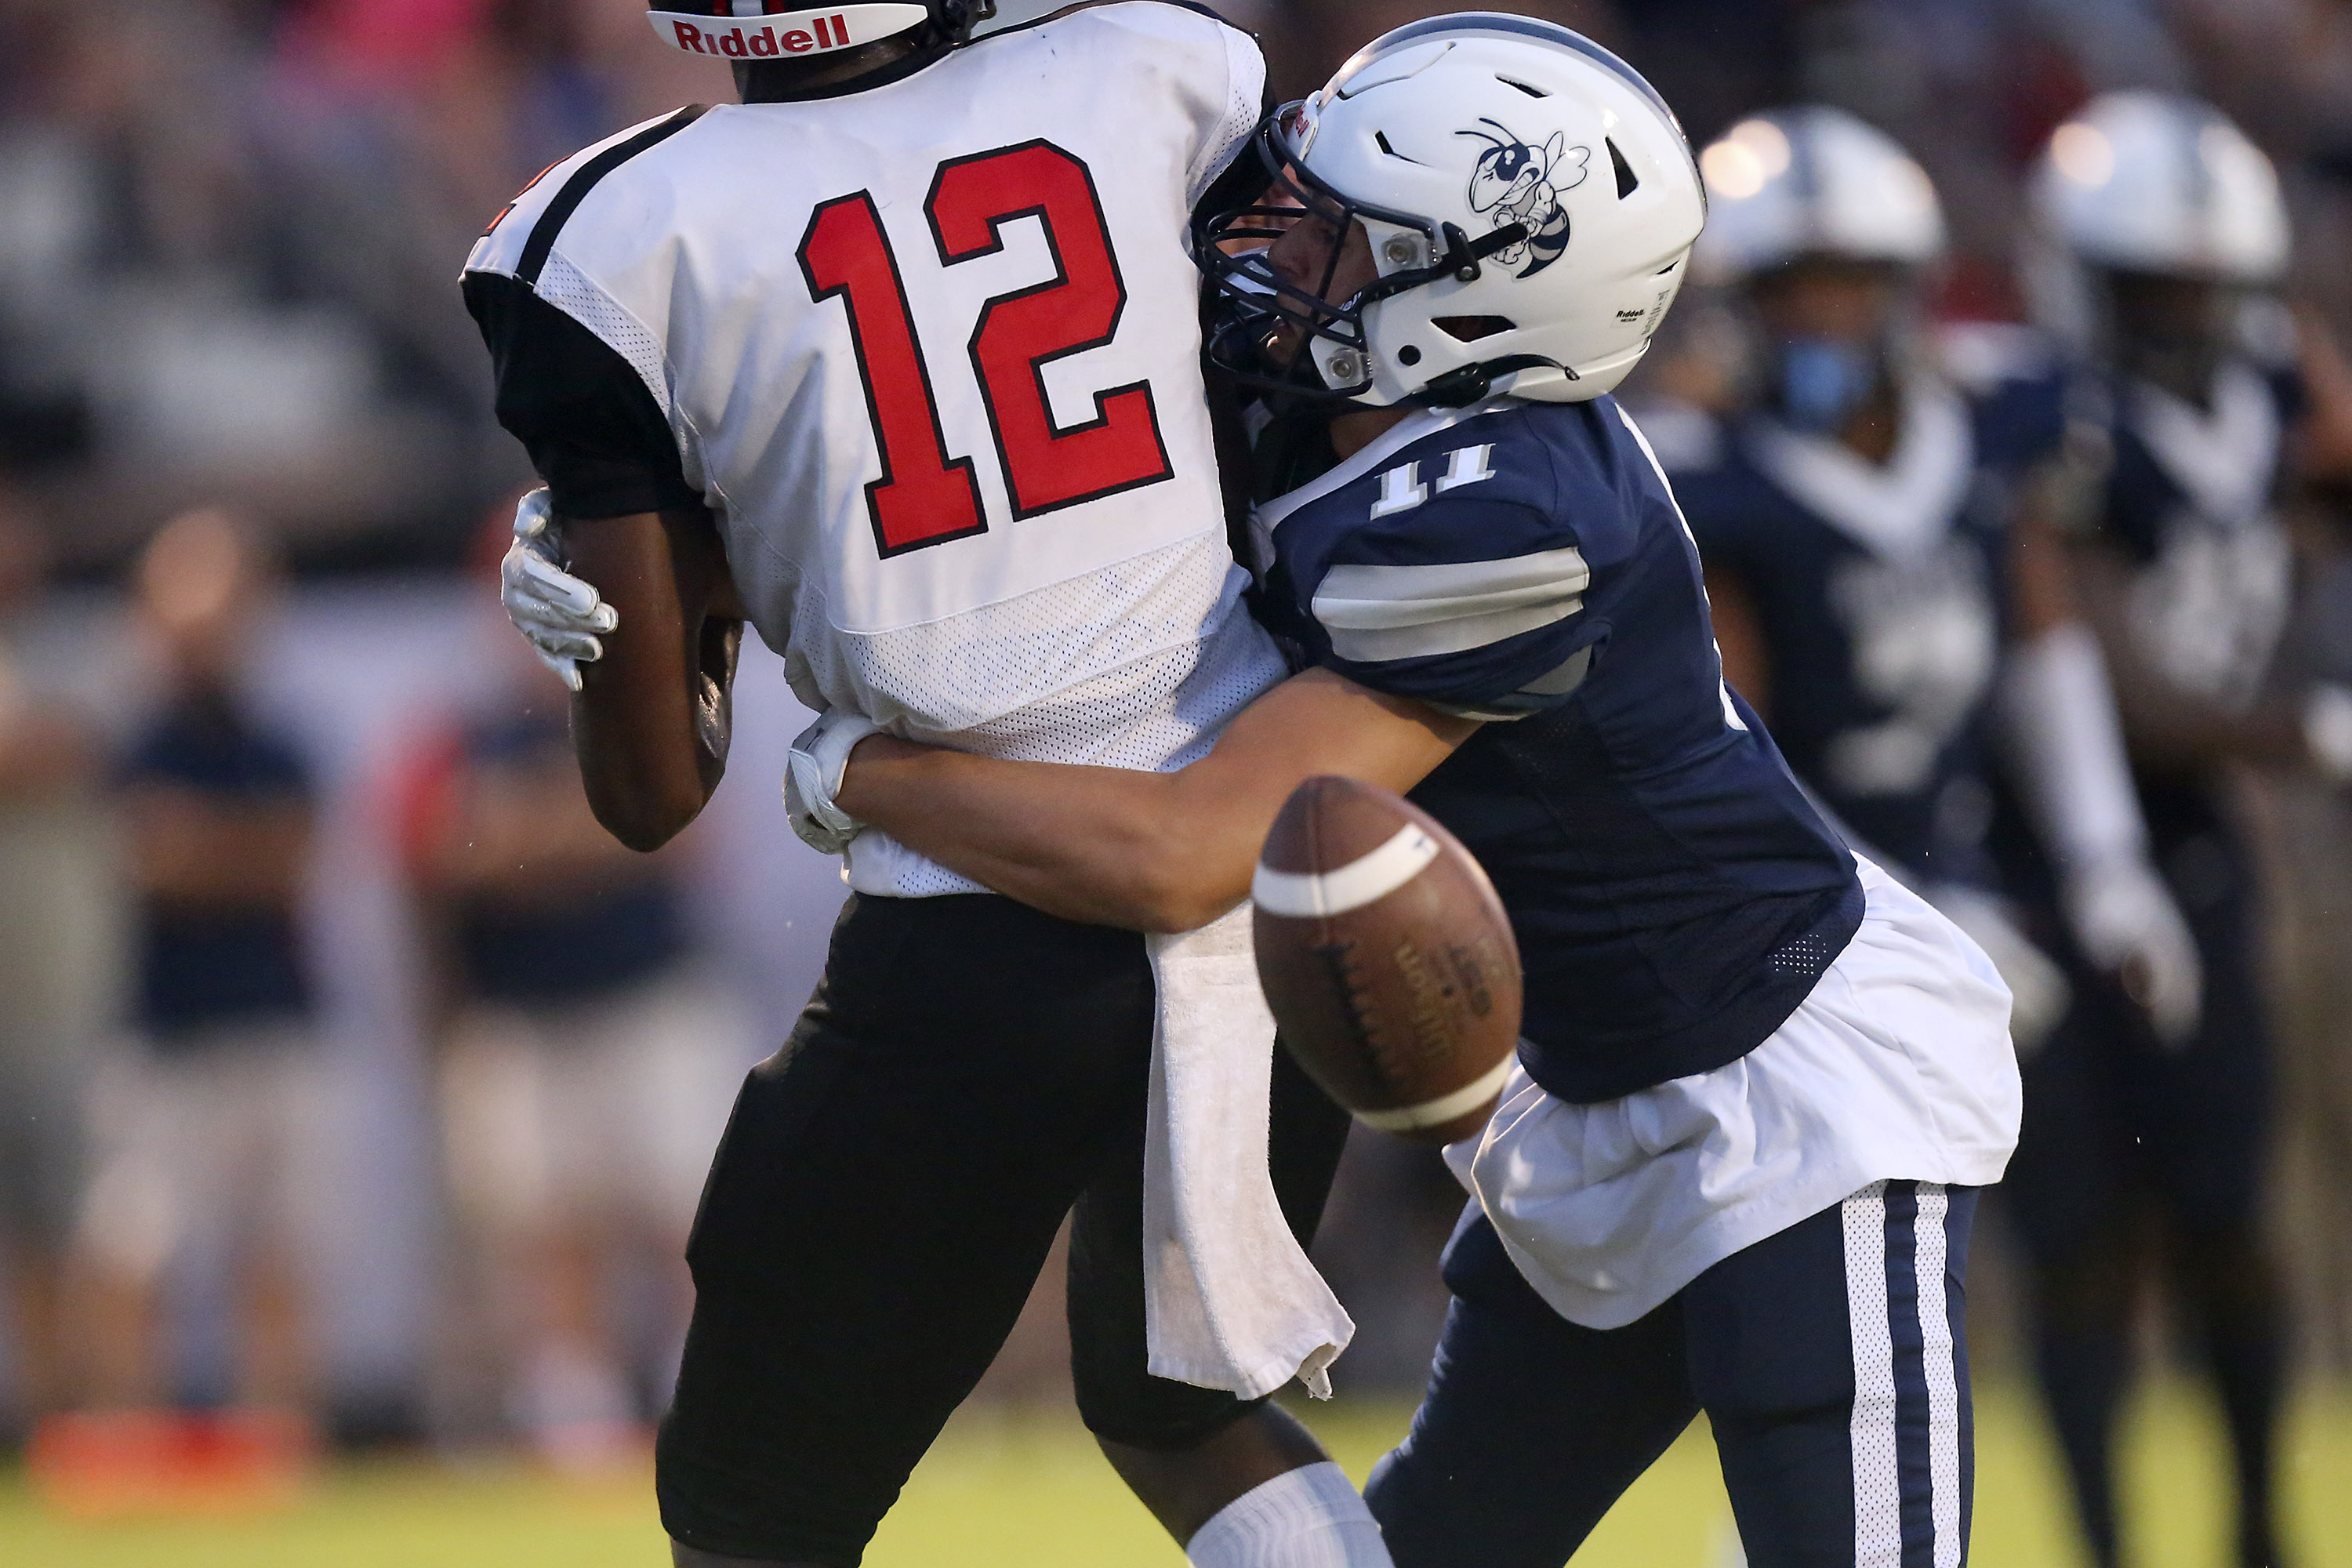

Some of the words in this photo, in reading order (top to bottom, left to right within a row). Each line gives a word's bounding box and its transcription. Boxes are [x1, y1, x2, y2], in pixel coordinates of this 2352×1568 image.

[672, 13, 851, 56] Riddell
[795, 138, 1174, 560] 12
[1370, 443, 1496, 521] 11
